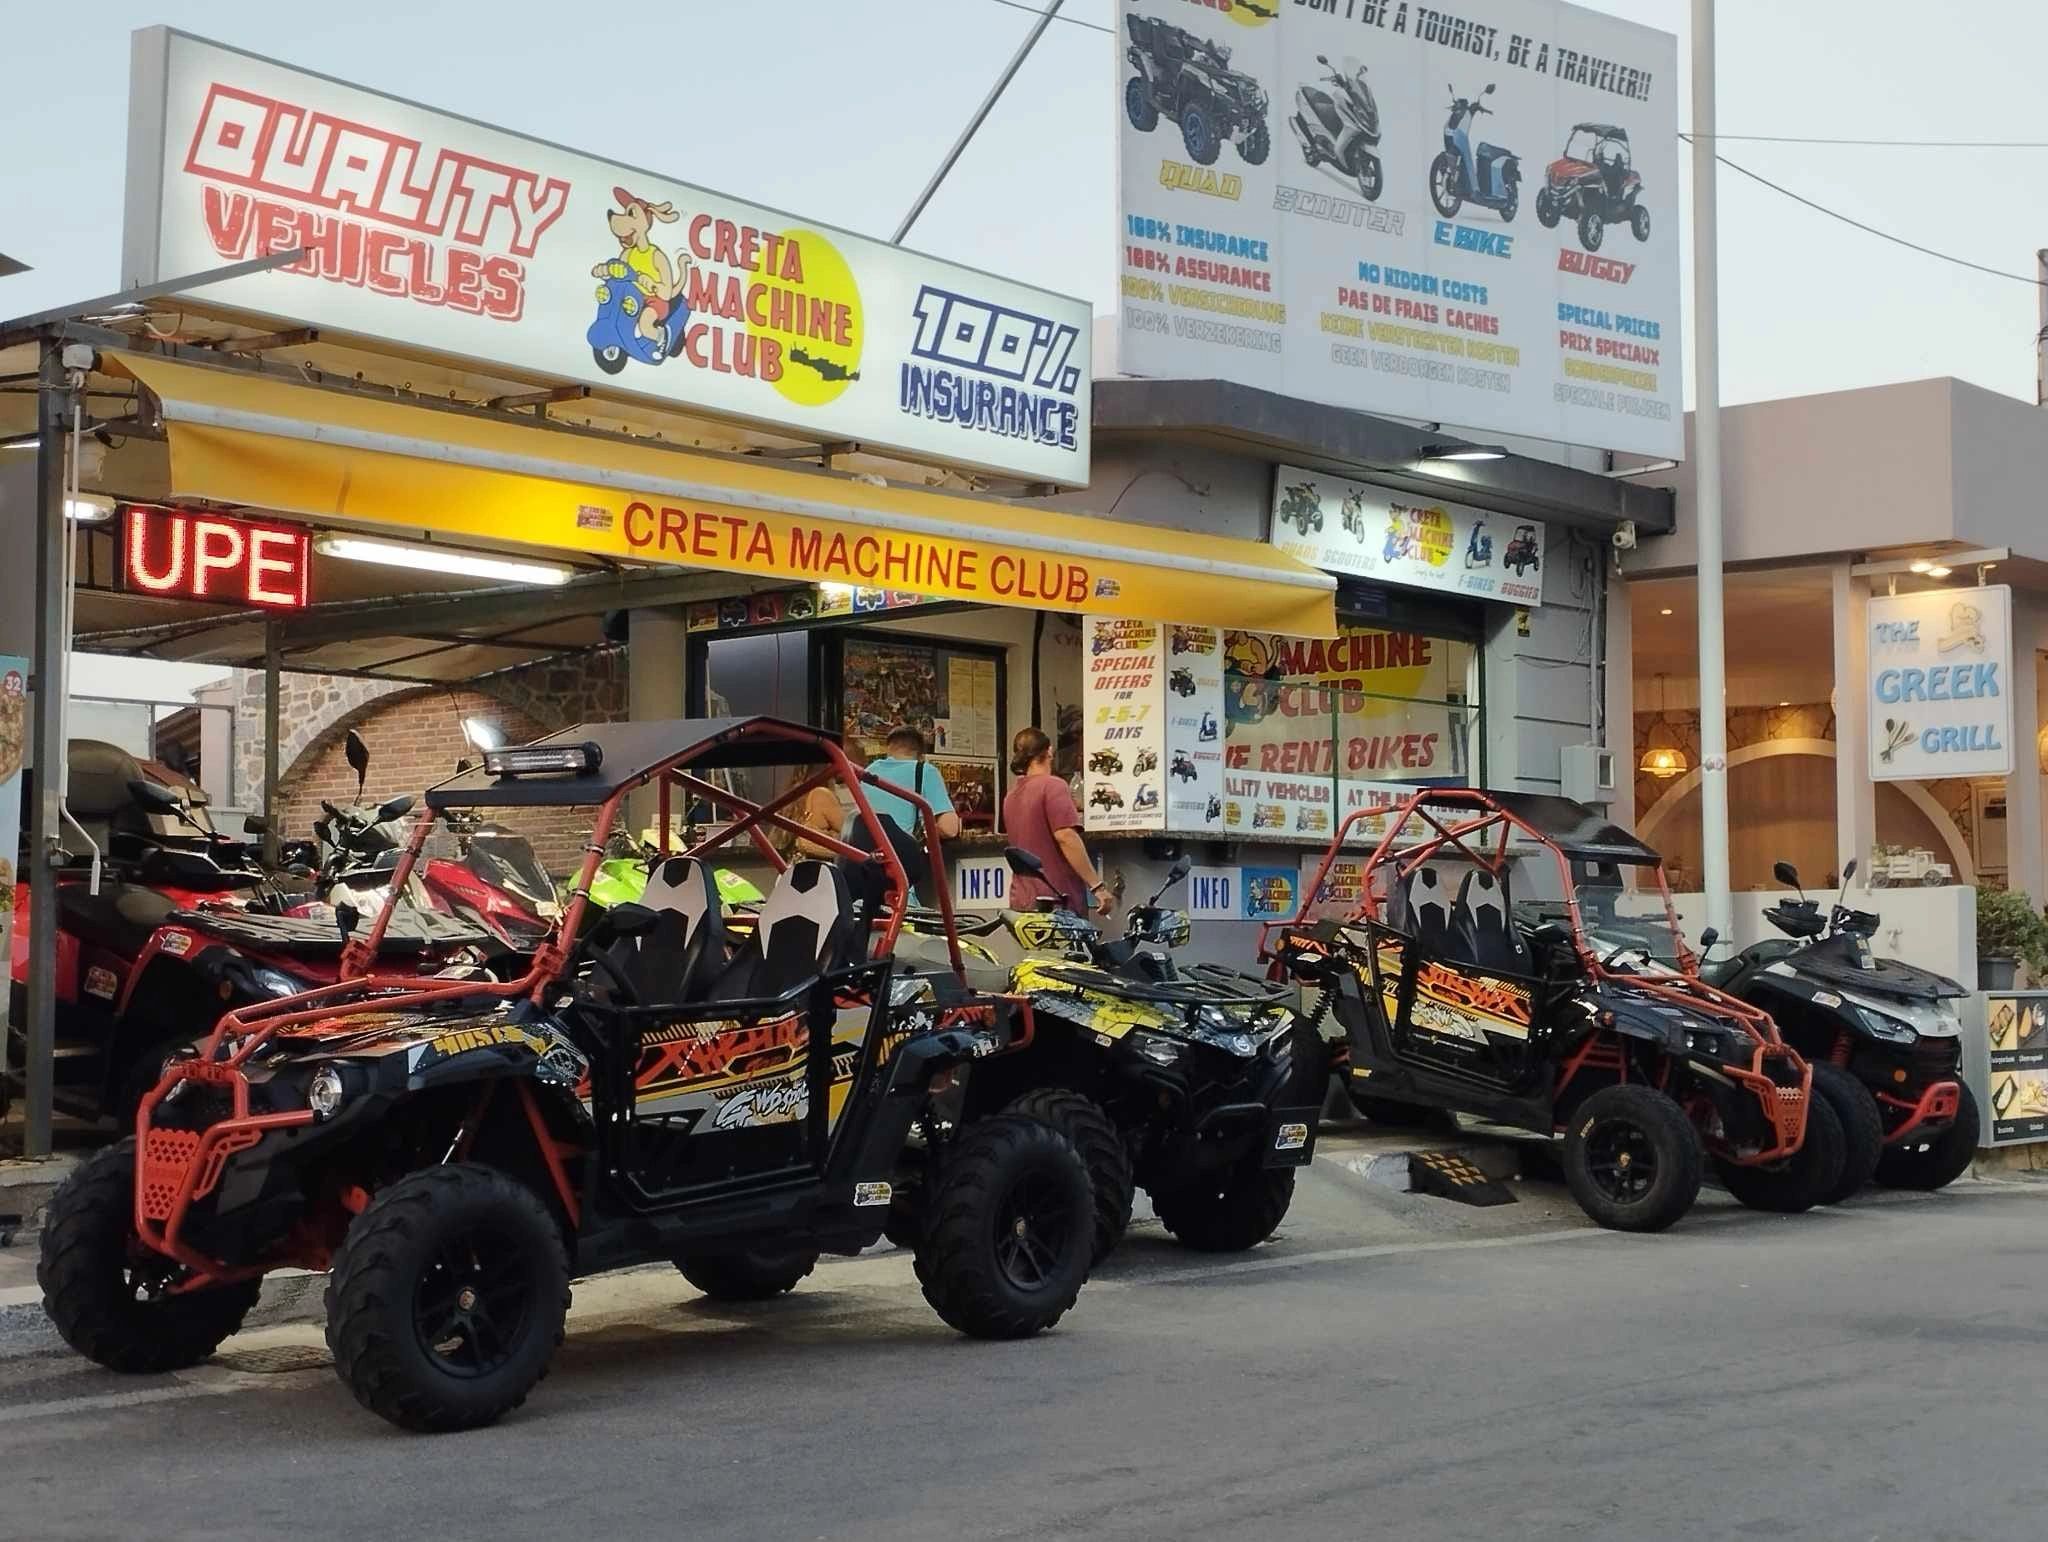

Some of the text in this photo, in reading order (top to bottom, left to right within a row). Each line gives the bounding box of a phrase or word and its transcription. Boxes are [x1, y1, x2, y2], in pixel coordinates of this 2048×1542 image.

[1415, 7, 1501, 62] TOURIST,
[1507, 34, 1533, 69] BE
[1535, 43, 1550, 74] A
[1555, 48, 1652, 102] TRAVELER!!
[183, 82, 571, 258] QUALITY
[1159, 159, 1243, 202] QUAD
[1273, 185, 1406, 236] SCOOTER
[203, 184, 525, 322] VEHICLES
[688, 213, 804, 284] CRETA
[1127, 214, 1269, 263] 100% INSURANCE
[1433, 220, 1515, 260] E BIKE
[1126, 245, 1272, 292] 100% ASSURANCE
[1358, 260, 1488, 306] NO HIDDEN COSTS
[1557, 248, 1637, 285] BUGGY
[686, 267, 853, 347] MACHINE
[1338, 286, 1500, 336] PAS DE FRAIS CACHES
[1557, 302, 1661, 341] SPECIAL PRICES
[686, 323, 785, 383] CLUB
[911, 284, 1081, 395] 100%
[1560, 330, 1660, 367] PRIX SPECIAUX
[900, 362, 1079, 452] INSURANCE
[130, 511, 309, 607] UPE
[623, 502, 1089, 604] CRETA MACHINE CLUB
[1875, 621, 1920, 643] THE
[1091, 655, 1157, 672] SPECIAL
[1280, 631, 1432, 677] MACHINE
[1094, 674, 1153, 690] OFFERS
[1113, 691, 1133, 700] FOR
[1279, 678, 1364, 718] CLUB
[1875, 662, 2000, 705] GREEK
[1104, 726, 1143, 740] DAYS
[1260, 740, 1334, 774] RENT
[1347, 733, 1439, 771] BIKES
[1920, 723, 2002, 755] GRILL
[1267, 782, 1330, 804] VEHICLES
[1347, 789, 1364, 806] AT
[961, 868, 1004, 900] INFO
[1193, 877, 1230, 910] INFO
